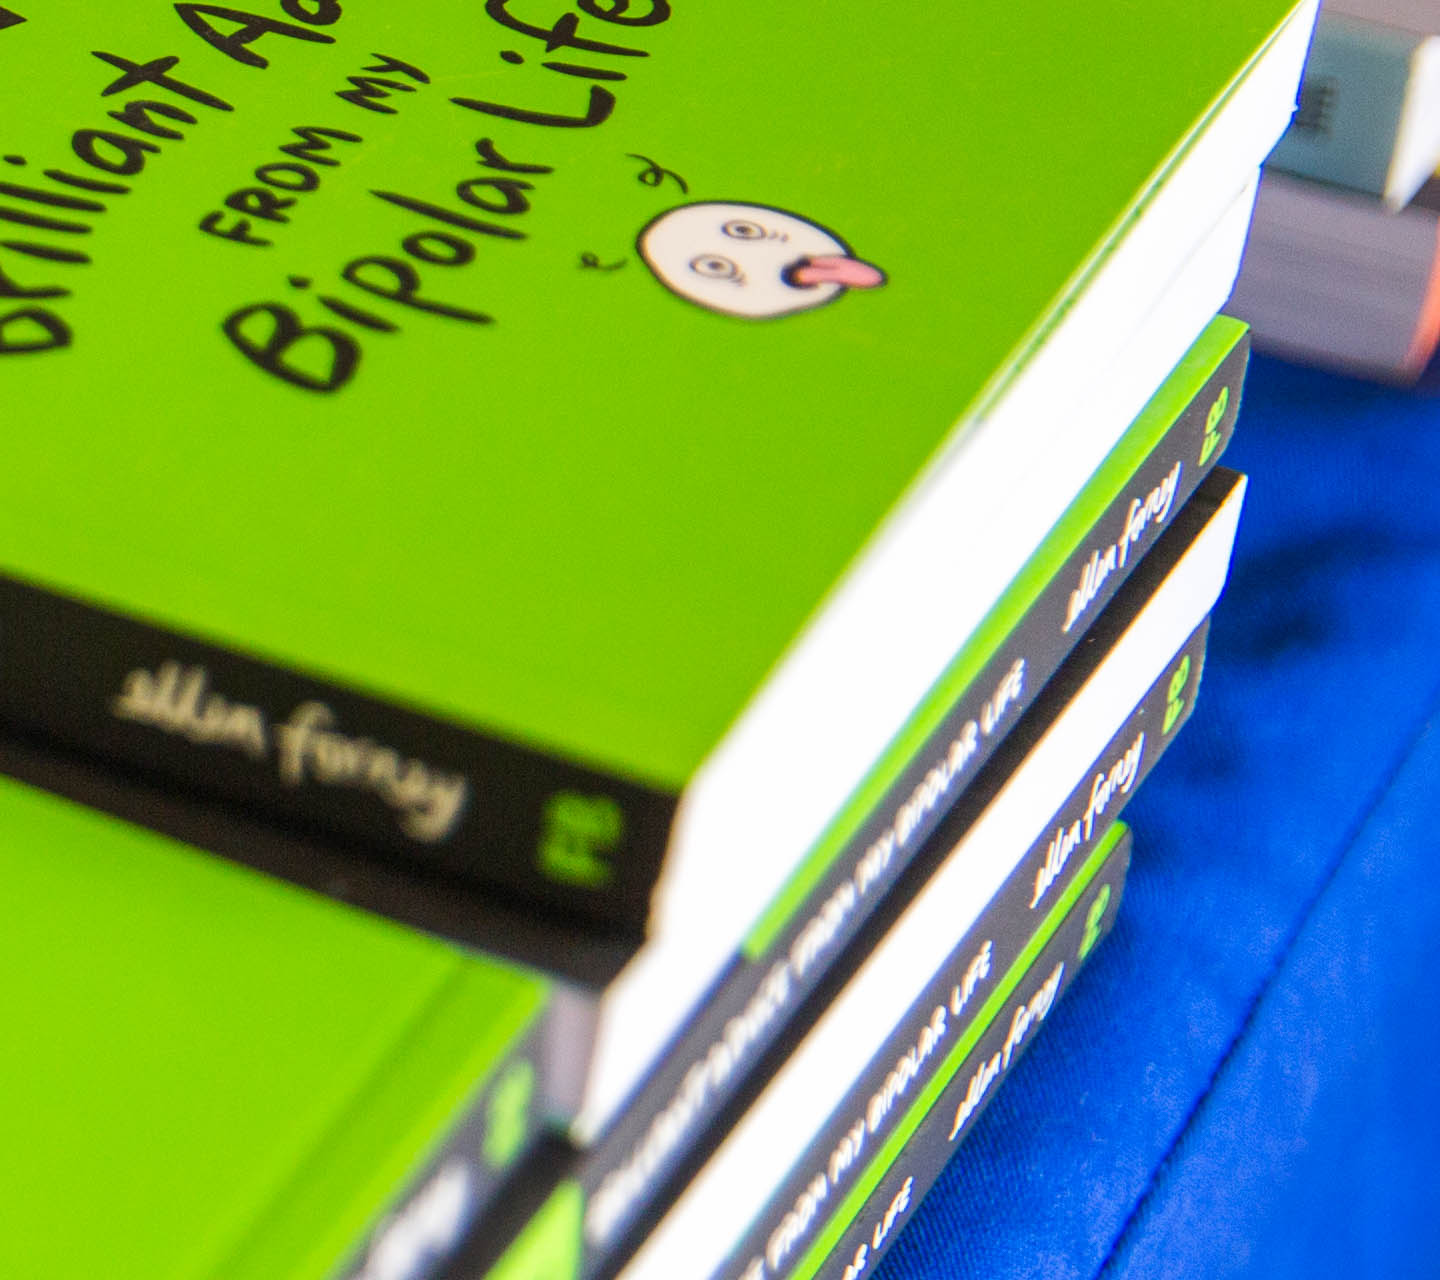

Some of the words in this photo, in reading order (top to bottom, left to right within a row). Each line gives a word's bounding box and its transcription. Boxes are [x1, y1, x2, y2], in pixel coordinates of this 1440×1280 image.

[199, 125, 363, 248] FROM
[335, 51, 432, 117] MY
[219, 139, 555, 396] Bipolar
[981, 657, 1025, 736] LIFE
[866, 1005, 947, 1134] BIPOLAR
[950, 940, 993, 1015] LIFE
[873, 1175, 913, 1249] LIFE
